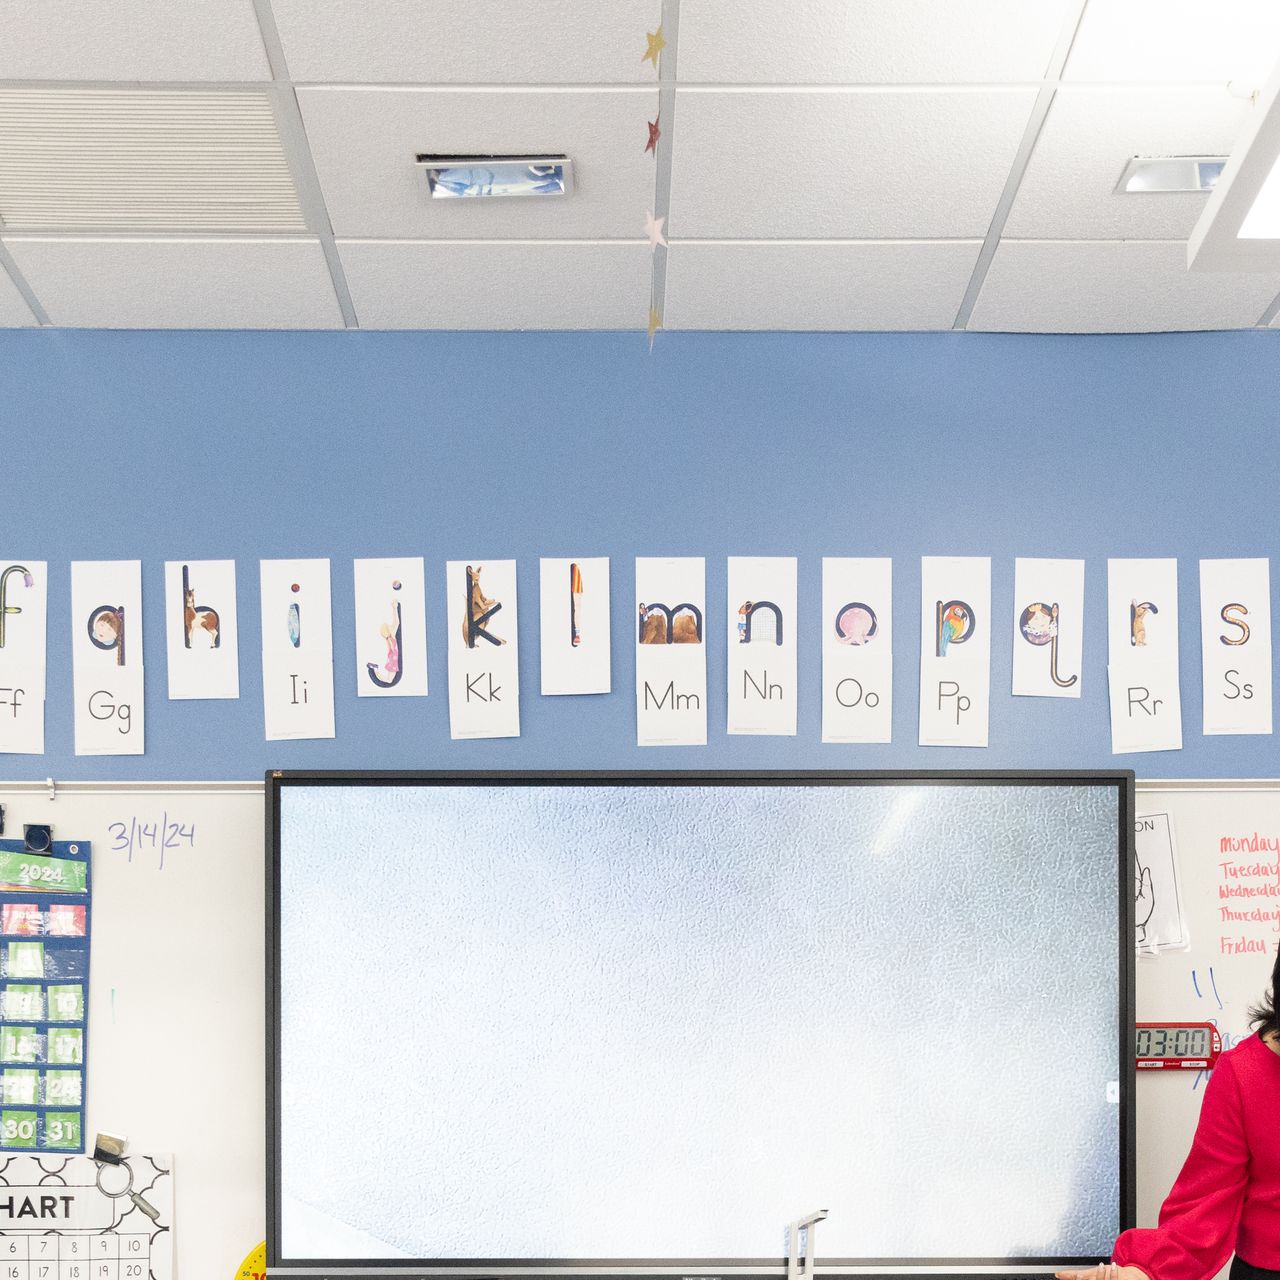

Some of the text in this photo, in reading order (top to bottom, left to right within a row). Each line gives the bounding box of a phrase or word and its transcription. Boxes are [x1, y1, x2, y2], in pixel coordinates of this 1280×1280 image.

[182, 563, 221, 649] h
[365, 579, 403, 689] j
[1019, 602, 1078, 689] q
[290, 674, 307, 704] Ii
[466, 672, 501, 703] Kk
[644, 680, 700, 710] Mm
[744, 669, 783, 700] Nn
[835, 678, 879, 708] Oo
[1223, 669, 1253, 700] Ss
[88, 690, 131, 735] Gg
[938, 681, 971, 725] Pp
[1128, 687, 1163, 717] Rr
[108, 810, 196, 871] 3/14/24
[19, 865, 64, 883] 2024
[1219, 861, 1280, 887] Tuesday
[1221, 936, 1266, 954] Friday
[1137, 1030, 1206, 1056] 03:00
[5, 1120, 33, 1139] 30
[51, 1121, 74, 1139] 31
